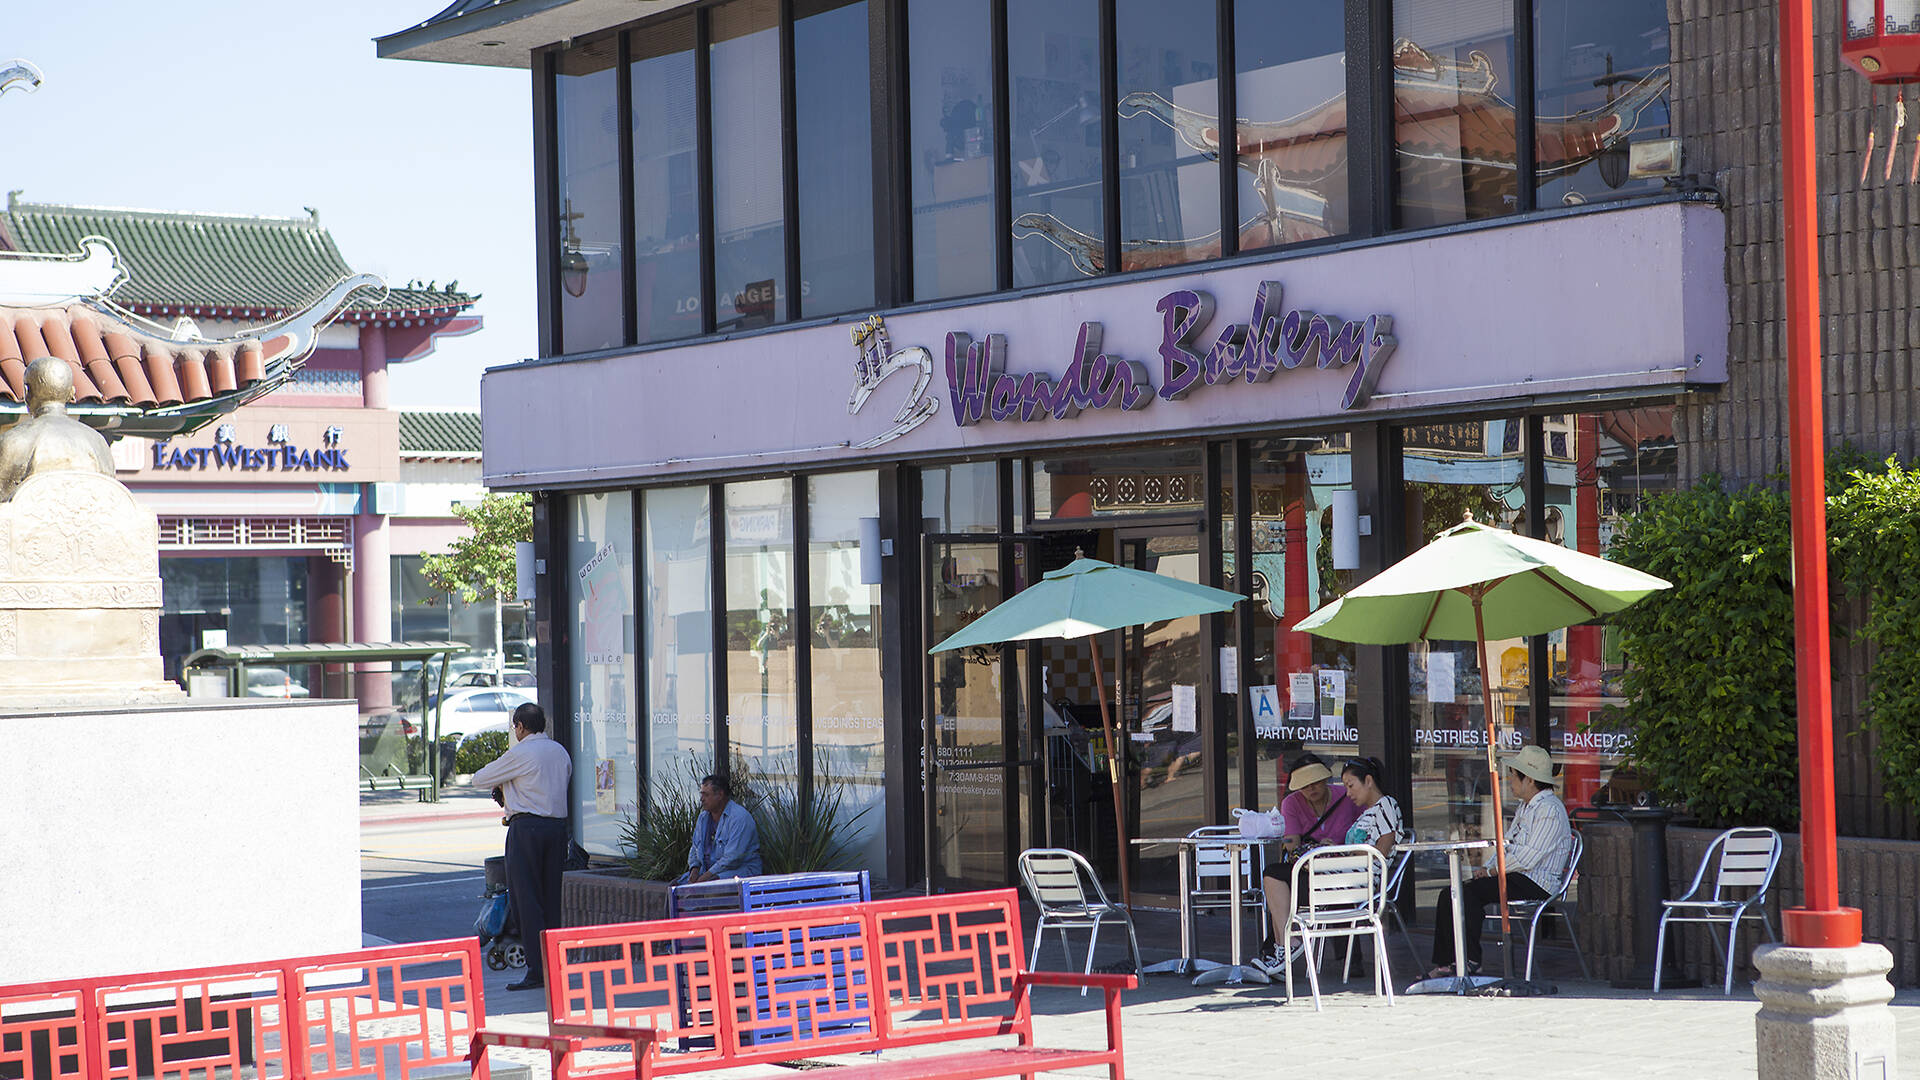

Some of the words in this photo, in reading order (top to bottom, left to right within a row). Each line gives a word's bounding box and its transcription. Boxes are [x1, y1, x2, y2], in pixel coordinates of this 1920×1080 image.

[720, 281, 810, 306] ANGELS
[945, 321, 1151, 427] Wonder
[1156, 280, 1396, 410] Bakery
[579, 544, 613, 578] wonder
[586, 654, 621, 663] juice
[1258, 693, 1274, 716] A
[1256, 726, 1295, 740] PARTY
[1297, 727, 1359, 741] CATERING
[1415, 729, 1479, 744] PASTRIES
[1563, 732, 1613, 748] BAKED
